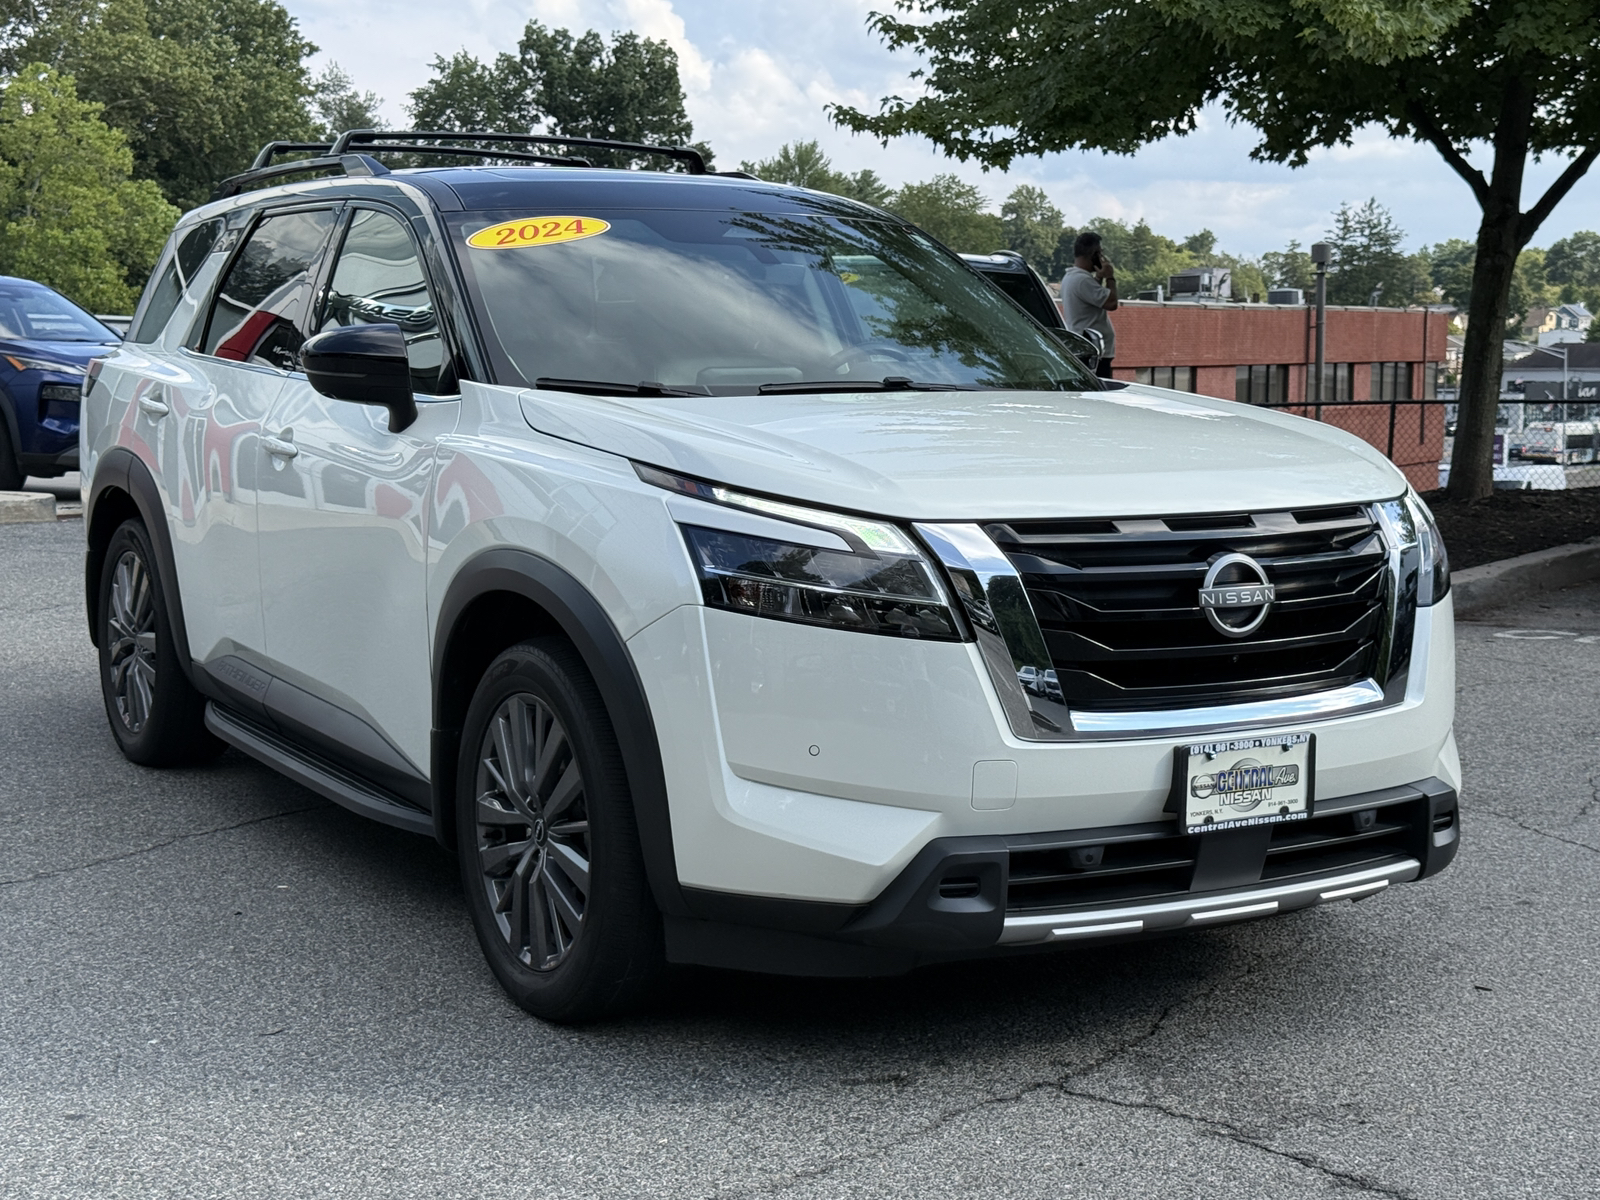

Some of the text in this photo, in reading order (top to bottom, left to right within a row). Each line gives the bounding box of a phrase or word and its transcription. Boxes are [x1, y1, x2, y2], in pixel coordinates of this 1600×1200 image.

[496, 219, 587, 246] 2024
[1201, 588, 1275, 605] NISSAN
[1217, 765, 1274, 793] CENTRAL
[1219, 788, 1273, 806] NISSAN
